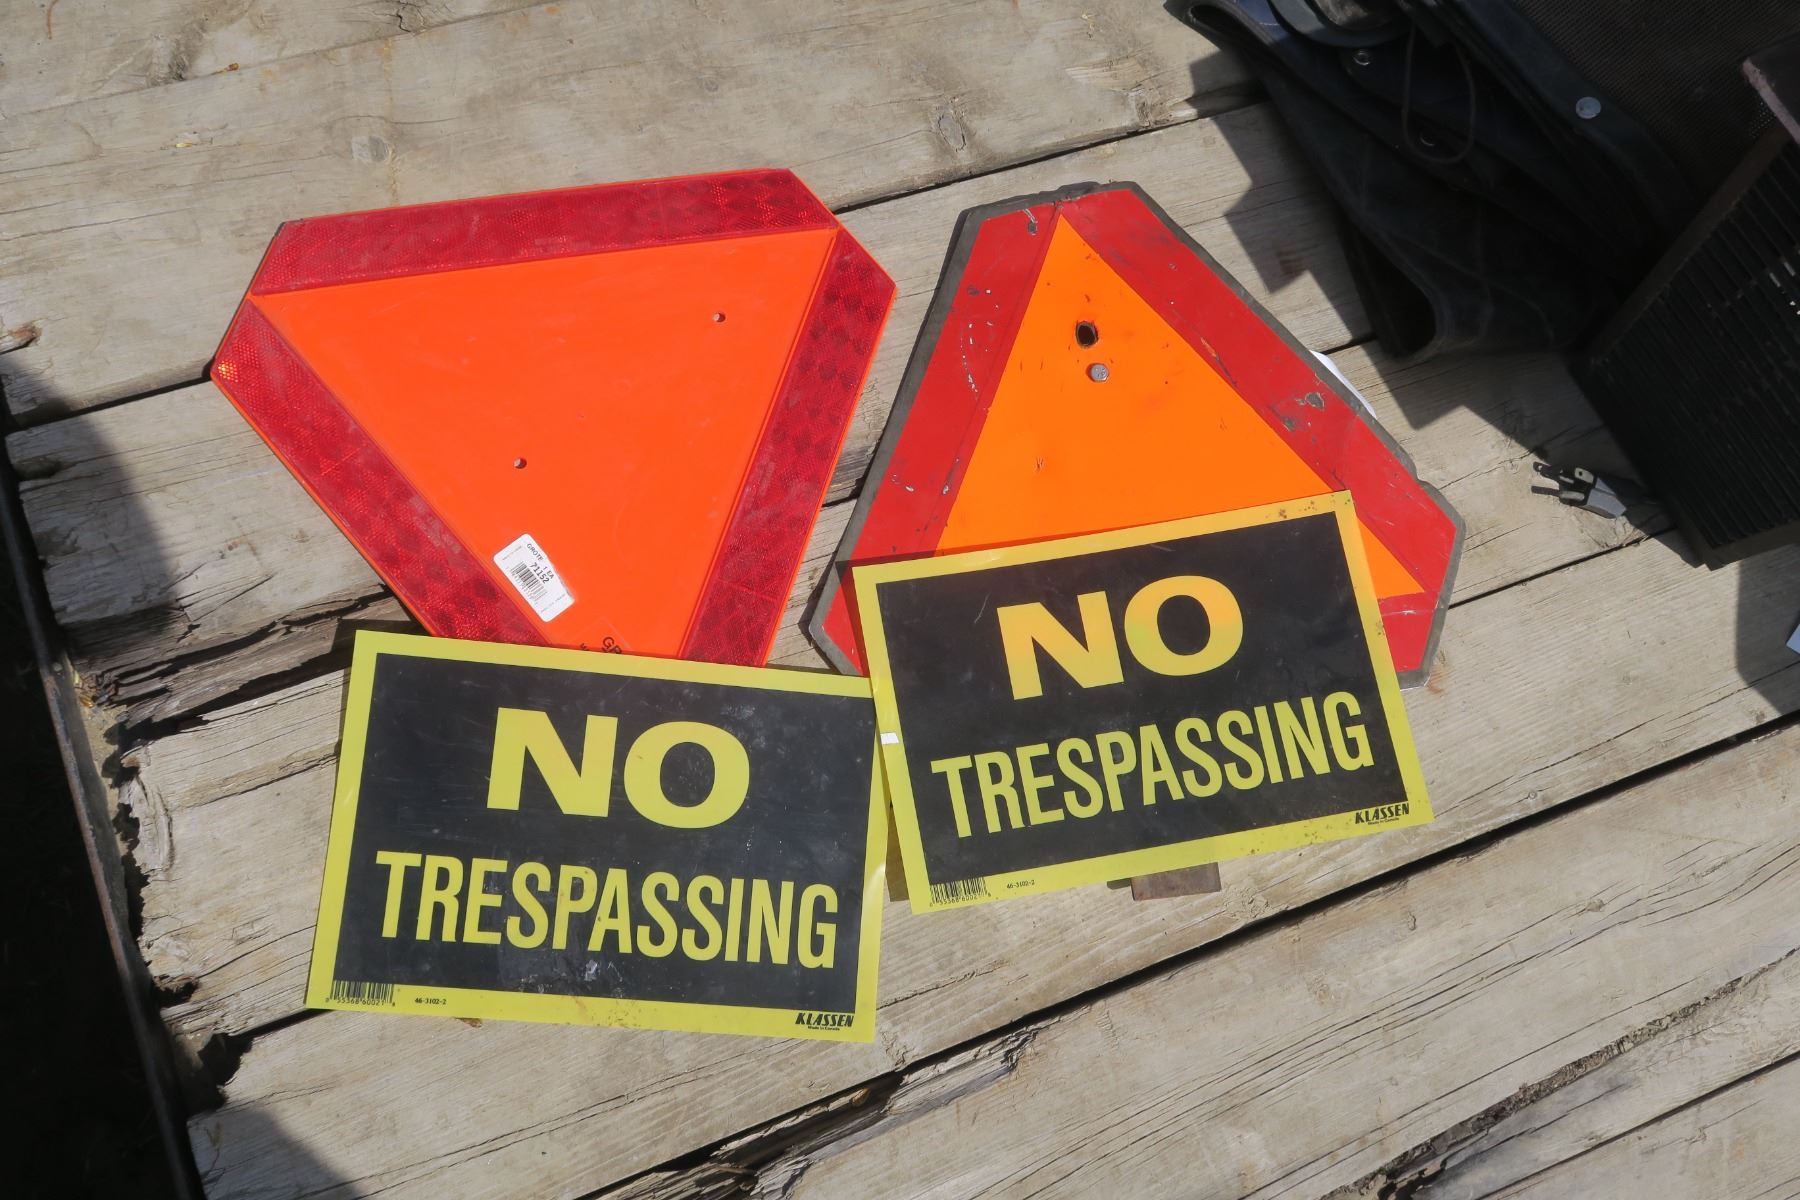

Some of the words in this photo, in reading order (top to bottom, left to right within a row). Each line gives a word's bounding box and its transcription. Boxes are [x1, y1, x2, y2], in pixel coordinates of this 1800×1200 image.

[530, 562, 550, 584] 71152
[997, 576, 1243, 699] NO
[488, 708, 749, 828] NO
[931, 692, 1374, 836] TRESPASSING
[1355, 802, 1410, 824] KLASSEN
[376, 851, 837, 968] TRESPASSING
[795, 1012, 855, 1027] KLASSEN
